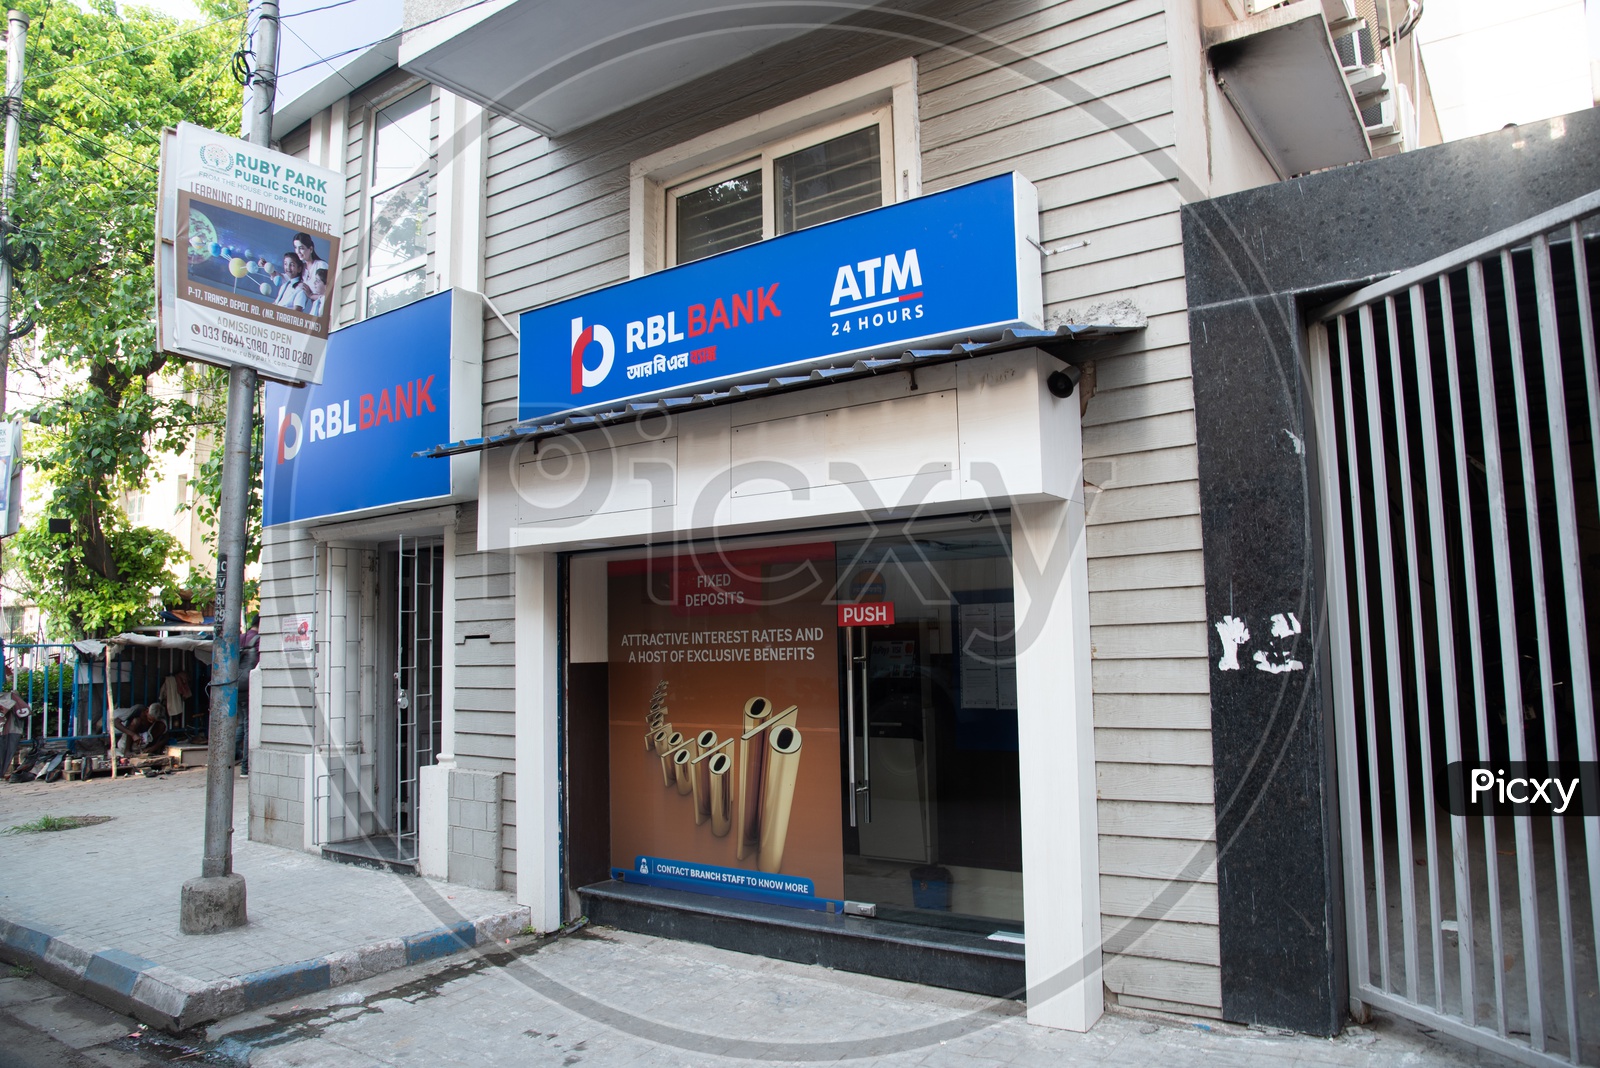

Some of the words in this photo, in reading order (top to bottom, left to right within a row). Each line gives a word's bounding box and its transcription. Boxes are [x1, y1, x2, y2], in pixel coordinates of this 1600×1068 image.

[234, 169, 280, 191] PUBLIC
[282, 184, 328, 207] SCHOOL
[236, 152, 281, 178] RUBY
[285, 168, 328, 194] PARK
[191, 181, 233, 205] LEARNING
[235, 195, 244, 209] IS
[246, 199, 252, 211] A
[255, 202, 285, 221] JOYOUS
[287, 211, 332, 235] EXPERIENCE
[199, 171, 220, 182] FROM
[222, 178, 236, 187] THE
[237, 182, 261, 195] HOUSE
[263, 190, 273, 198] OF
[274, 194, 288, 204] DPS
[289, 199, 307, 210] RUBY
[308, 205, 326, 215] PARK
[829, 248, 923, 306] ATM
[188, 286, 203, 301] P-17,
[204, 291, 228, 307] TRANSP.
[230, 299, 249, 313] DEPOT.
[251, 304, 260, 316] RD.
[262, 308, 275, 320] (NR.
[276, 312, 304, 328] TARATALA
[626, 310, 684, 354] RBL
[687, 282, 782, 338] BANK
[831, 320, 852, 337] 24
[858, 304, 924, 330] HOURS
[202, 325, 219, 340] 033
[221, 330, 245, 348] 6644
[272, 344, 290, 361] 7130
[292, 349, 313, 366] 0280
[217, 316, 268, 339] ADMISSIONS
[270, 331, 292, 345] OPEN
[310, 400, 356, 443] RBL
[359, 374, 436, 431] BANK
[685, 591, 744, 607] DEPOSITS
[697, 573, 731, 588] FIXED
[843, 606, 887, 623] PUSH
[621, 632, 690, 647] ATTRACTIVE
[691, 630, 750, 645] INTEREST
[752, 628, 793, 643] RATES
[795, 627, 824, 641] AND
[628, 651, 636, 663] A
[638, 651, 668, 663] HOST
[670, 650, 685, 662] OF
[687, 648, 751, 662] EXCLUSIVE
[754, 647, 815, 661] BENEFITS
[657, 864, 689, 876] CONTACT
[690, 870, 721, 881] BRANCH
[722, 874, 745, 885] STAFF
[747, 877, 757, 886] TO
[758, 879, 783, 890] KNOW
[784, 883, 808, 894] MORE
